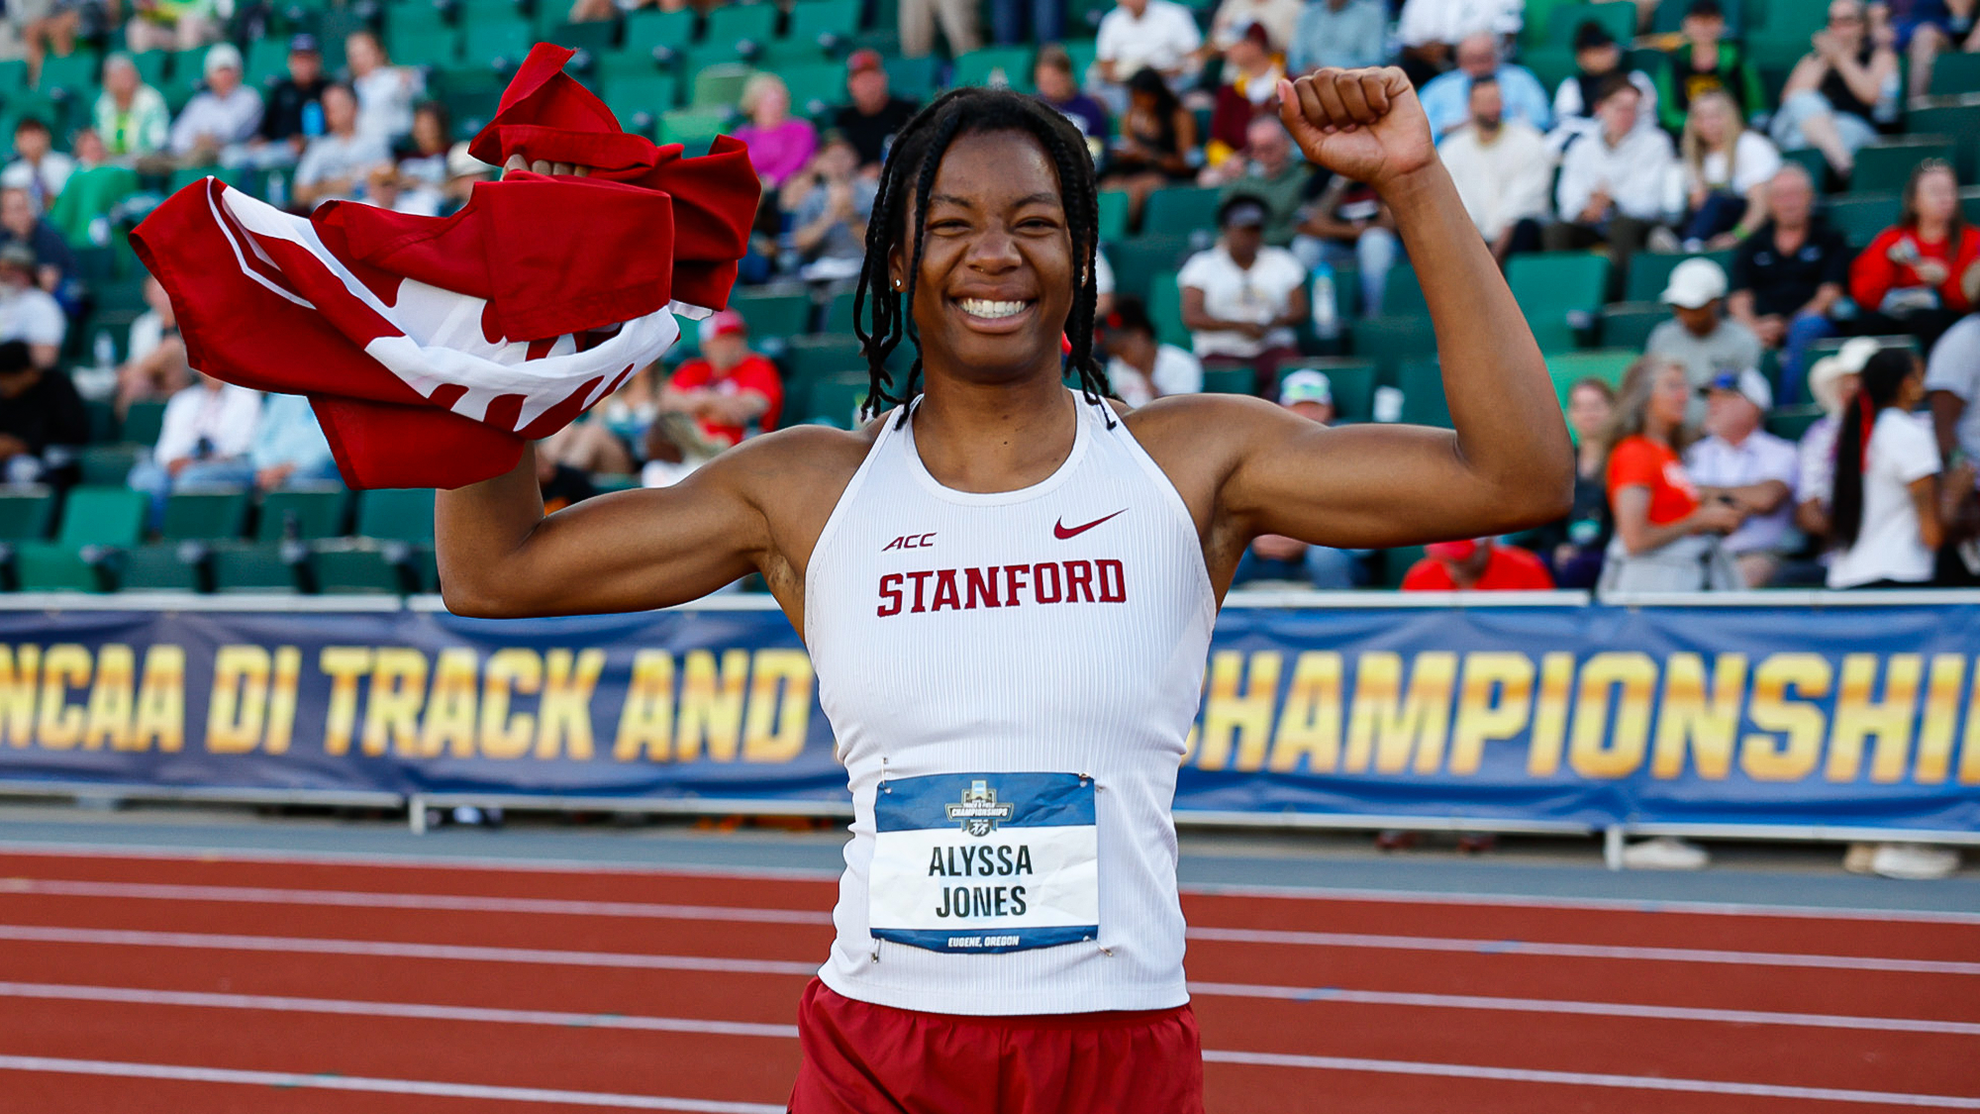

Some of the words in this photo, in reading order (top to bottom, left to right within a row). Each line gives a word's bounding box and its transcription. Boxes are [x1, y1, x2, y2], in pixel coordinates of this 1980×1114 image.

[881, 532, 938, 552] ACC
[877, 559, 1127, 618] STANFORD
[0, 642, 186, 754] NCAA
[205, 644, 302, 756] DI
[320, 646, 606, 762] TRACK
[615, 648, 814, 765] AND
[1179, 649, 1980, 787] HAMPIONSHI
[951, 807, 1008, 817] CHAMPIONSHIPS
[928, 844, 1033, 877] ALYSSA
[936, 885, 1027, 918] JONES
[947, 936, 983, 948] EUGENE,
[984, 935, 1020, 947] OREGON
